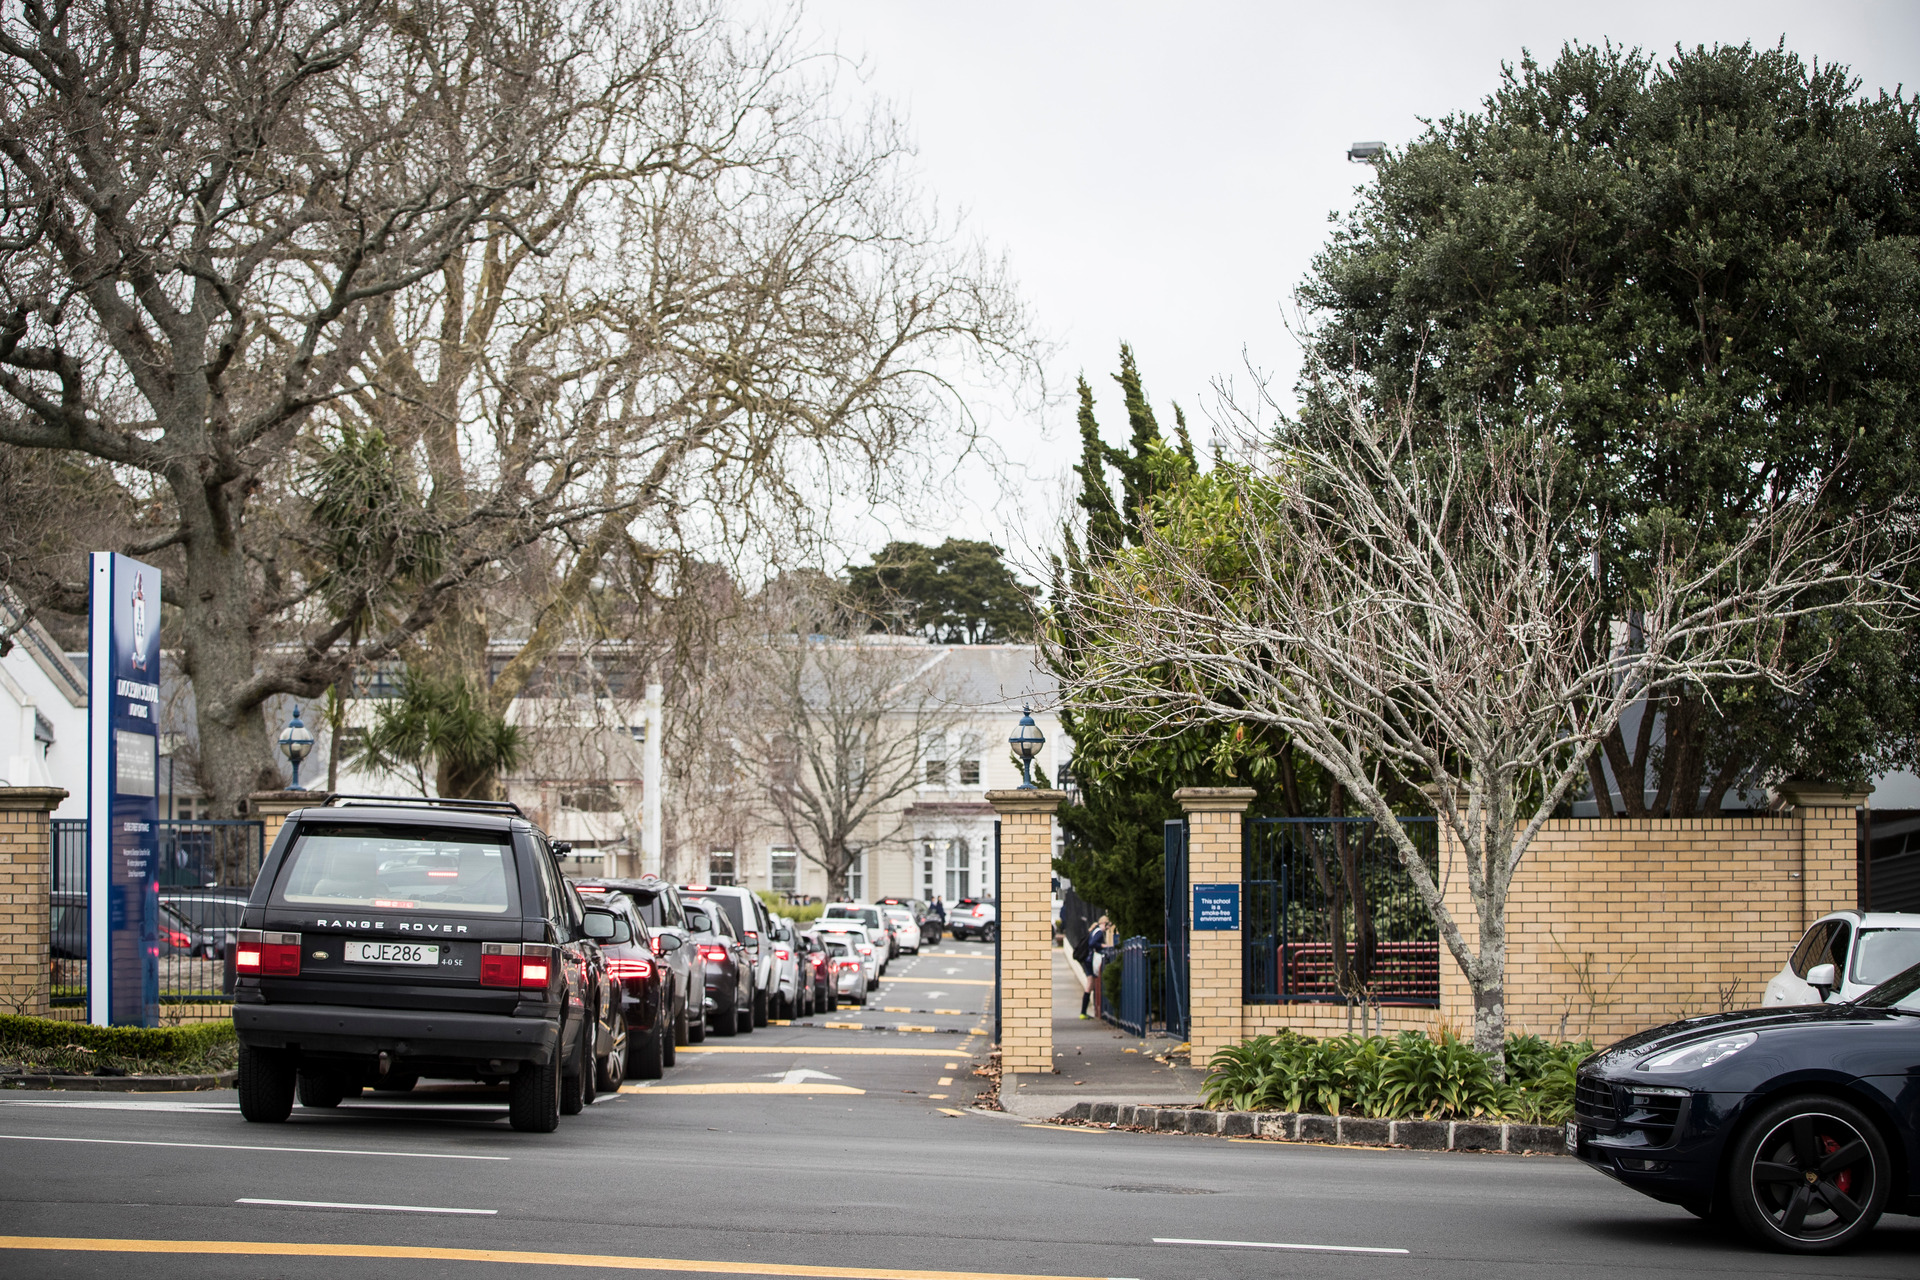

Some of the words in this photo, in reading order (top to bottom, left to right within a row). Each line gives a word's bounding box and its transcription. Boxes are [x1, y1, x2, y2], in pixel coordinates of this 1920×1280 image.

[317, 919, 385, 929] RANGE
[399, 923, 468, 933] ROVER
[361, 944, 422, 962] CJE286
